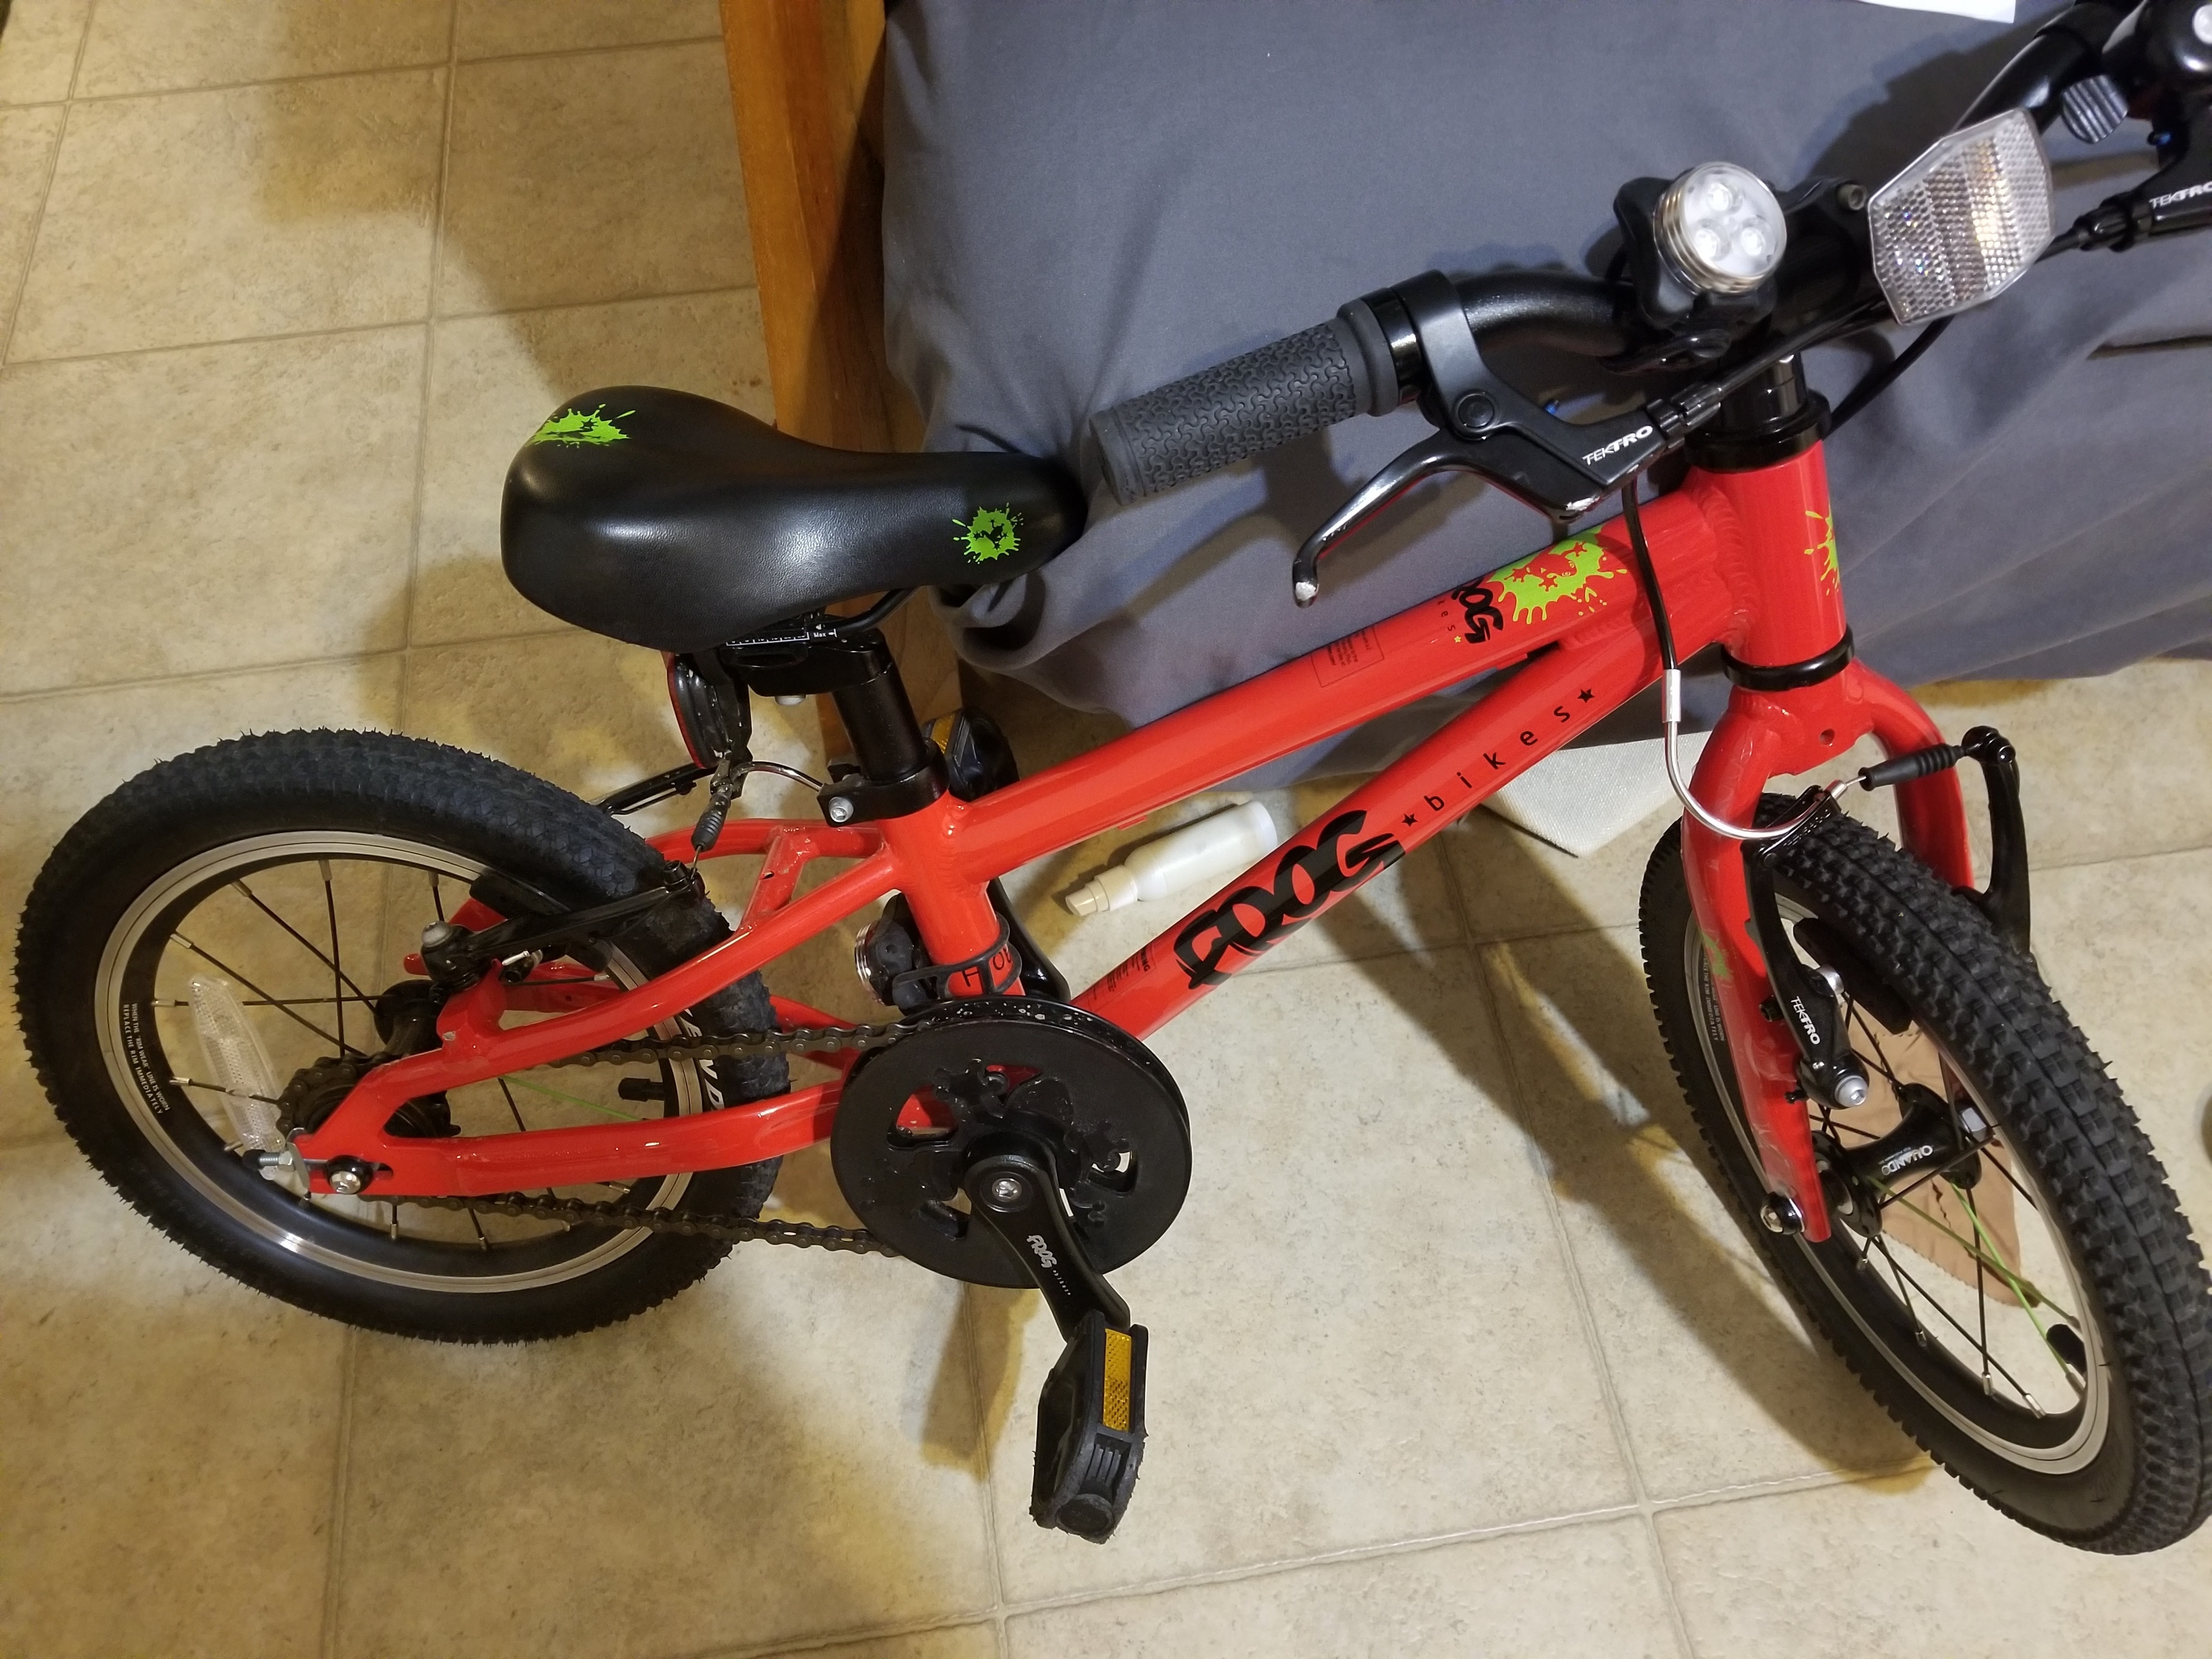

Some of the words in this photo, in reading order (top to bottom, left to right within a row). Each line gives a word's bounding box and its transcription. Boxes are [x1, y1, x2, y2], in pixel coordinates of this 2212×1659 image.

[1582, 426, 1653, 465] TEKTRO
[1424, 706, 1571, 811] bikes
[1173, 810, 1406, 990] FROG
[1791, 996, 1820, 1045] TEKTRO
[123, 1004, 132, 1034] REPLACE
[130, 1050, 139, 1064] RIM
[135, 1066, 163, 1114] IMMEDIATELY
[146, 1071, 156, 1085] LINE
[156, 1091, 170, 1110] WORN
[1882, 1145, 1933, 1176] QUANDO
[1026, 1235, 1057, 1268] FROG
